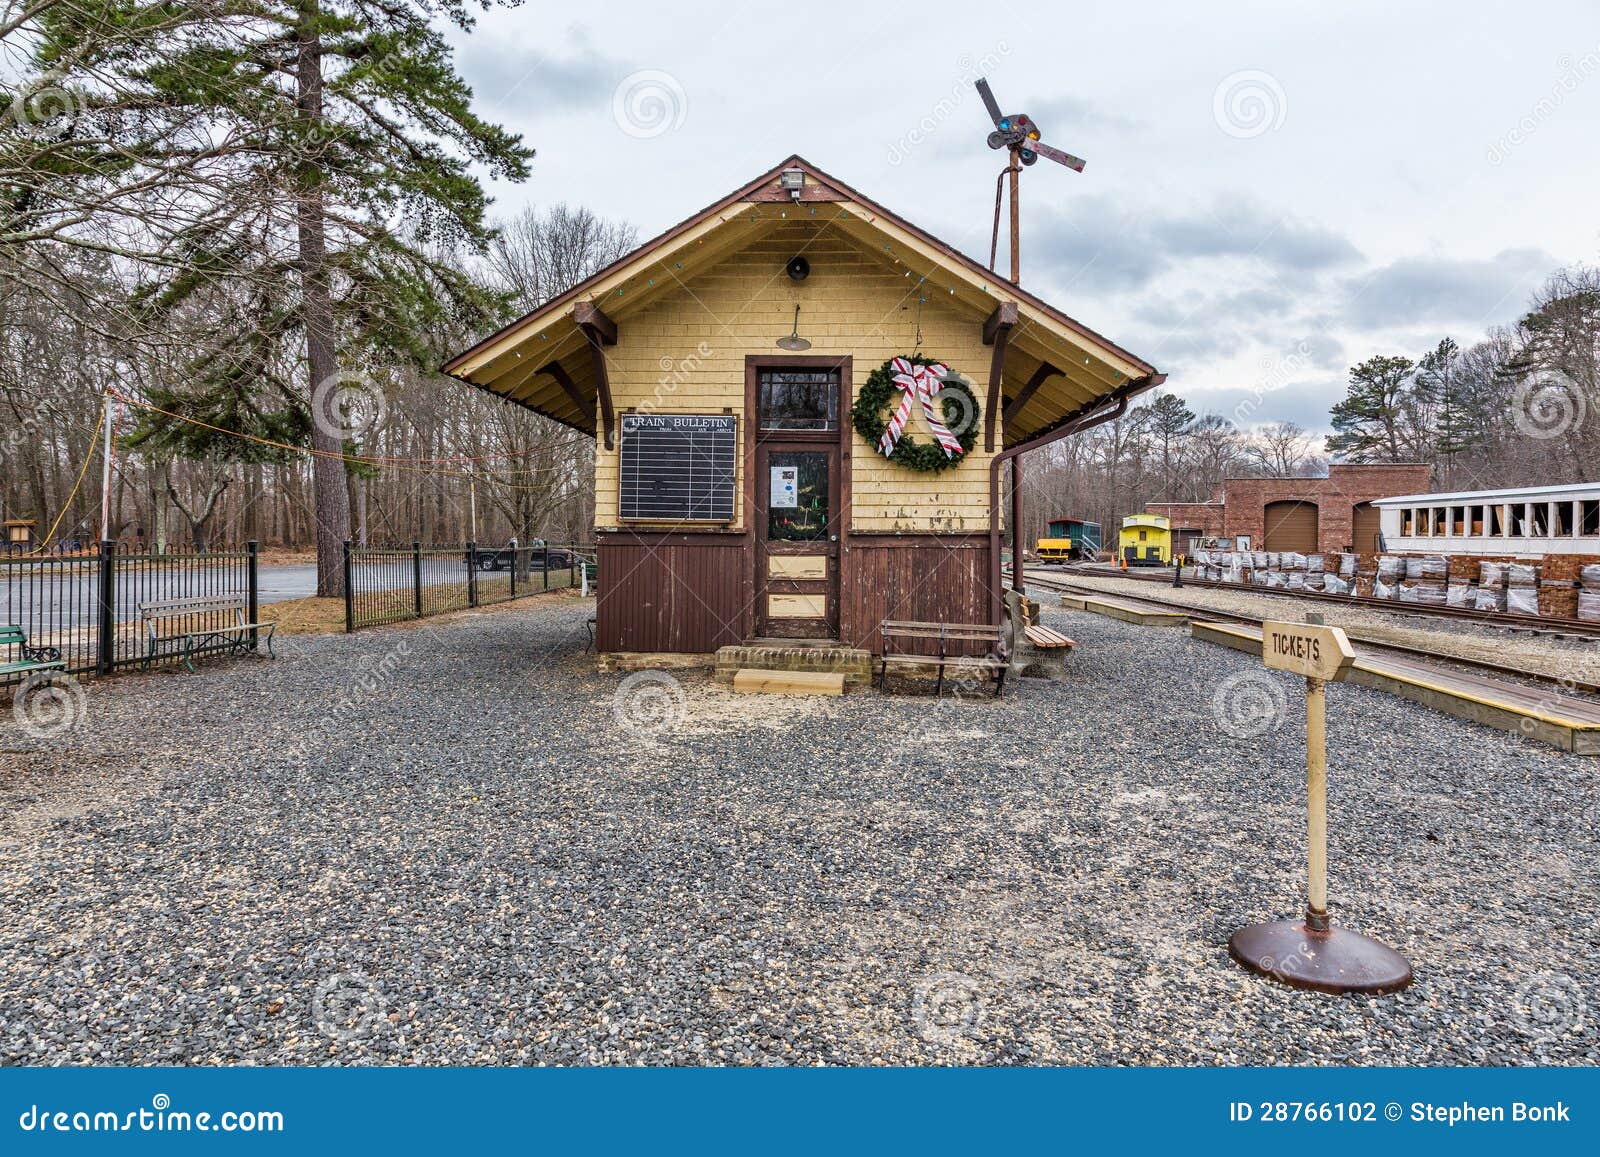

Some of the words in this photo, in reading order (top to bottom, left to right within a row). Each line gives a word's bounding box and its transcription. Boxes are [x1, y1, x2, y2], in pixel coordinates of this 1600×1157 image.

[629, 417, 665, 427] TRAIN
[673, 418, 729, 428] BULLETIN
[1272, 632, 1320, 661] TICKETS
